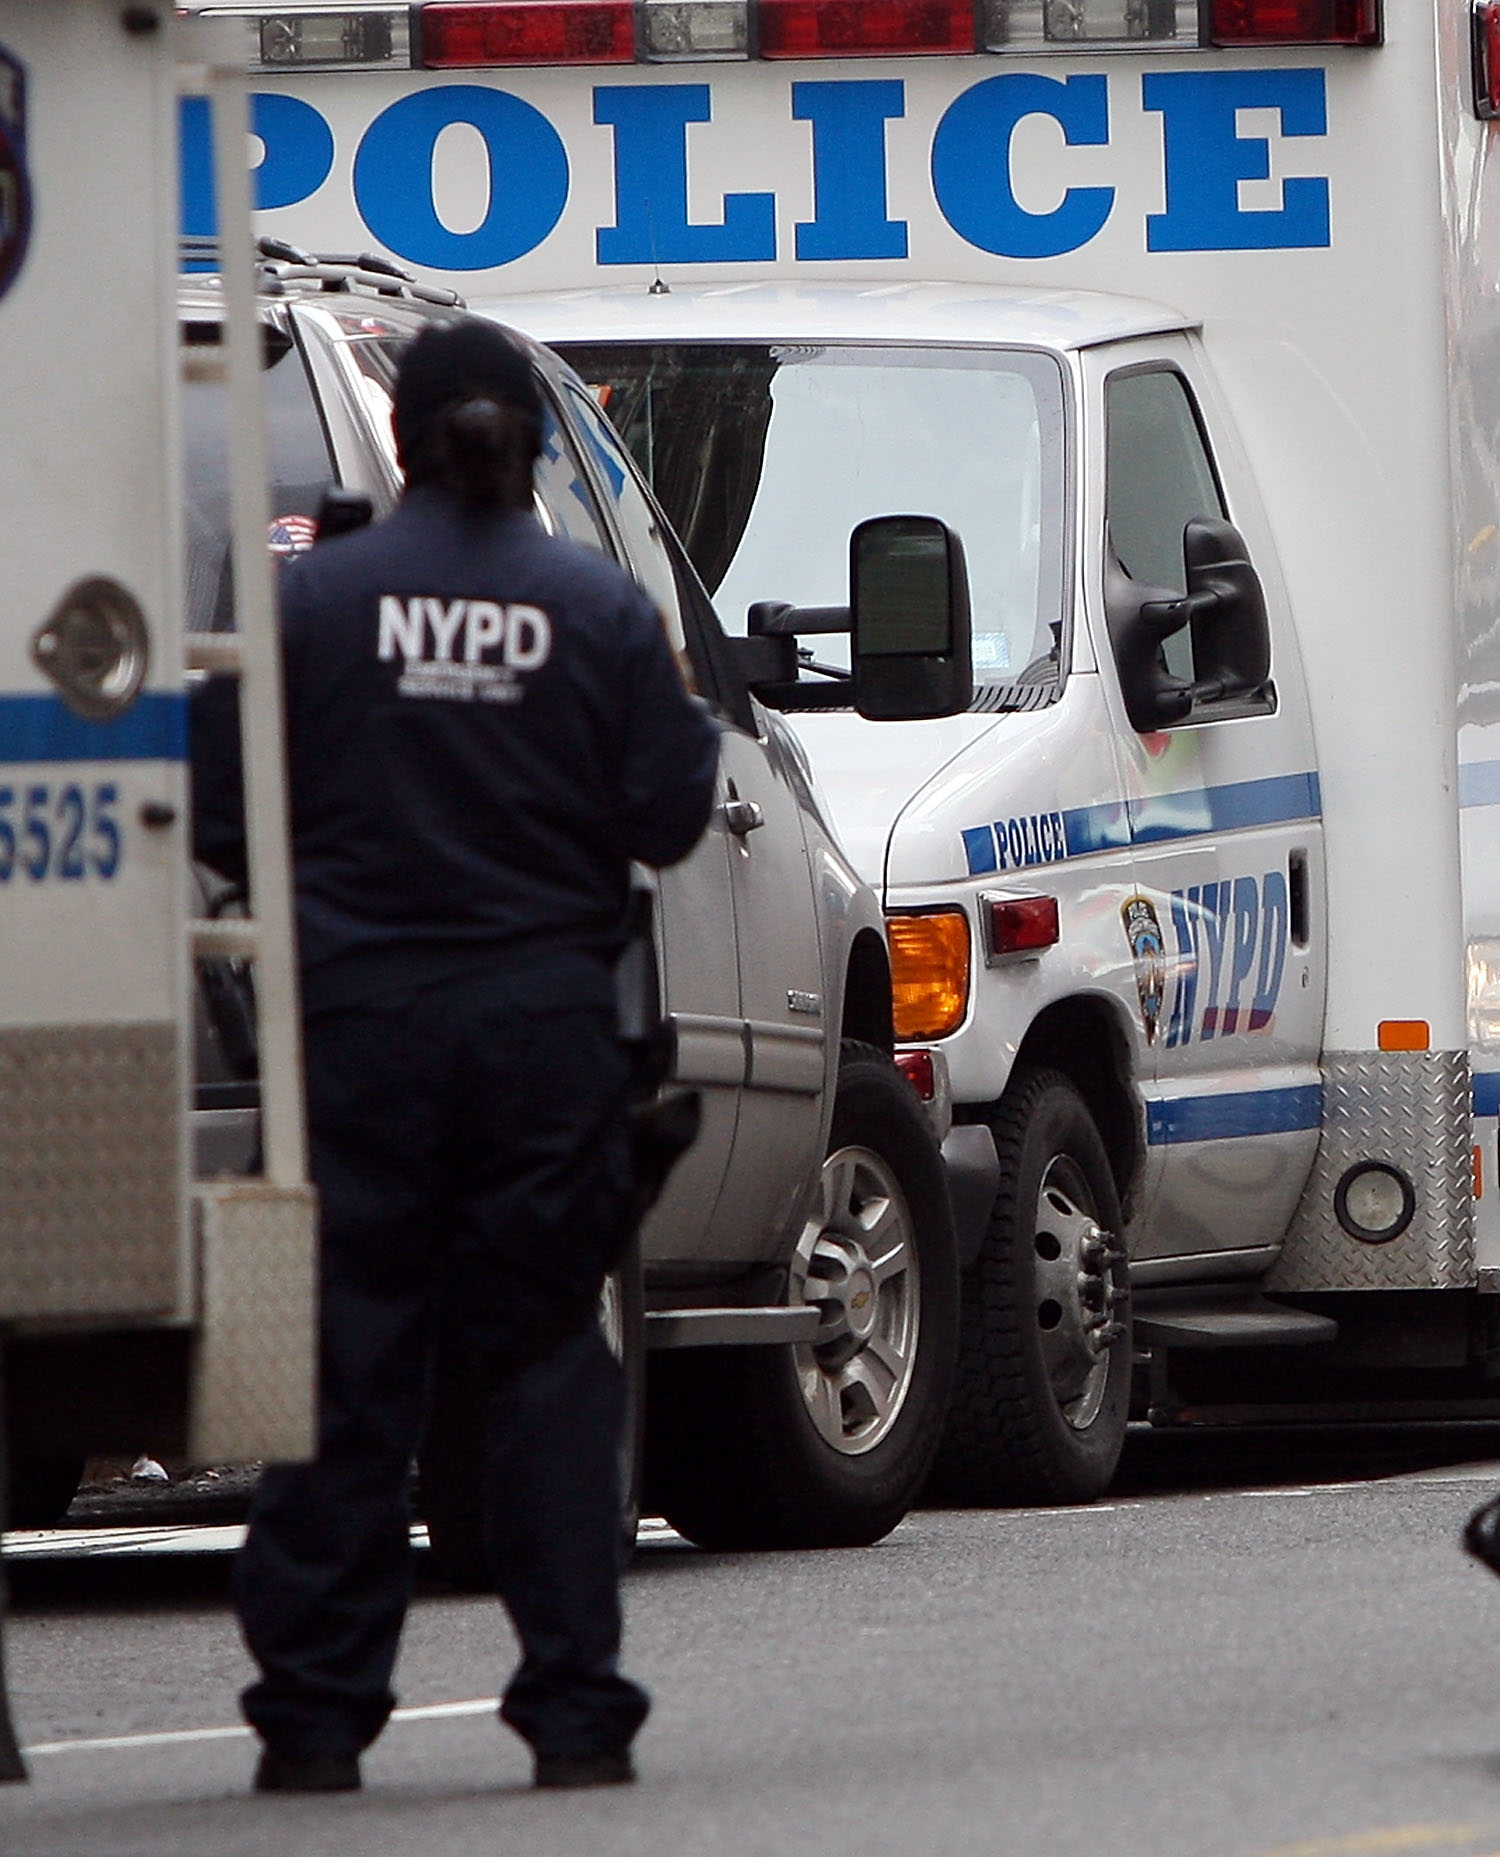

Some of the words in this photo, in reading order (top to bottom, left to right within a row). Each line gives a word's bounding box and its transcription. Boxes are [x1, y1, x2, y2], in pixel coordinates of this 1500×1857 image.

[178, 67, 1332, 273] POLICE
[378, 595, 552, 671] NYPD
[993, 811, 1065, 869] POLICE
[1166, 871, 1289, 1049] NYPD
